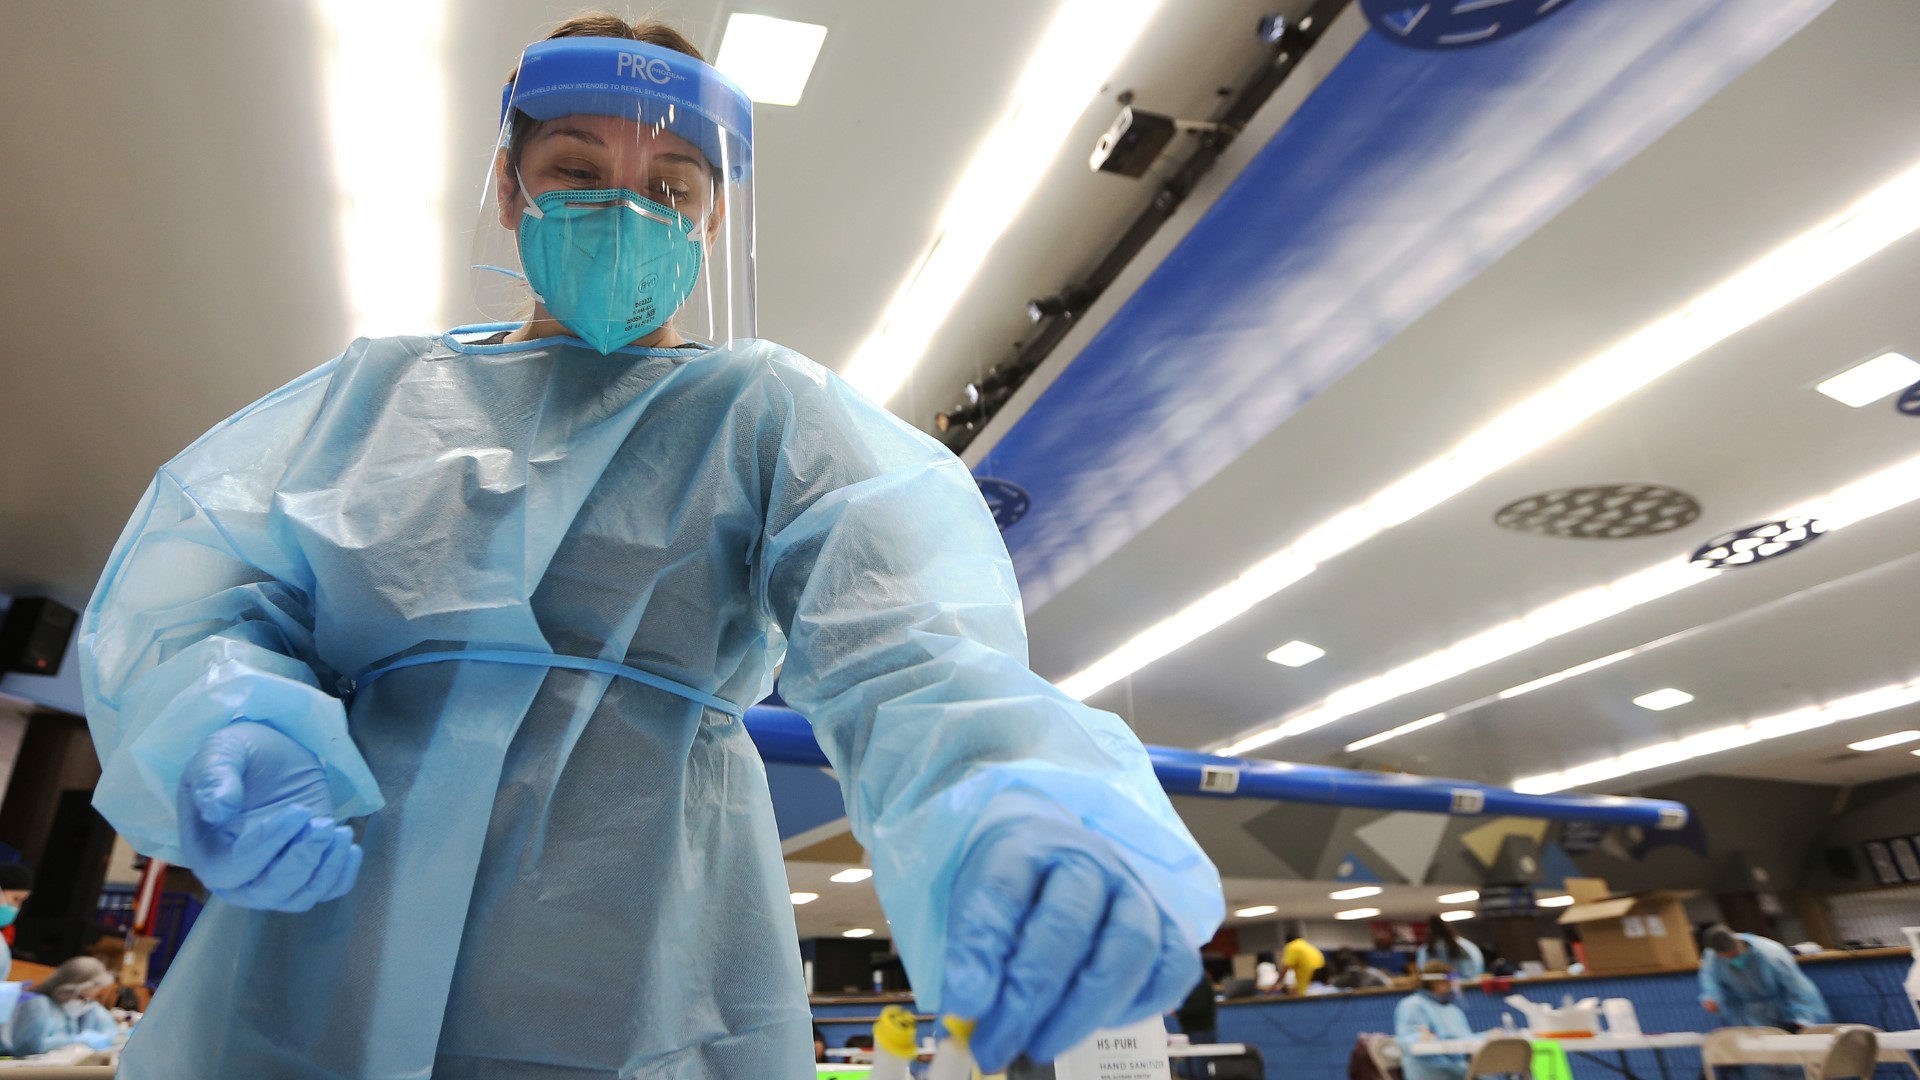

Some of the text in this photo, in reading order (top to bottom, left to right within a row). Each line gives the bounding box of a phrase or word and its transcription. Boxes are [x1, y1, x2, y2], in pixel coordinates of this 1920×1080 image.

[617, 52, 671, 84] PRO
[620, 85, 643, 94] REPEL
[644, 88, 680, 103] SPLASHING
[1100, 1063, 1127, 1071] HAND
